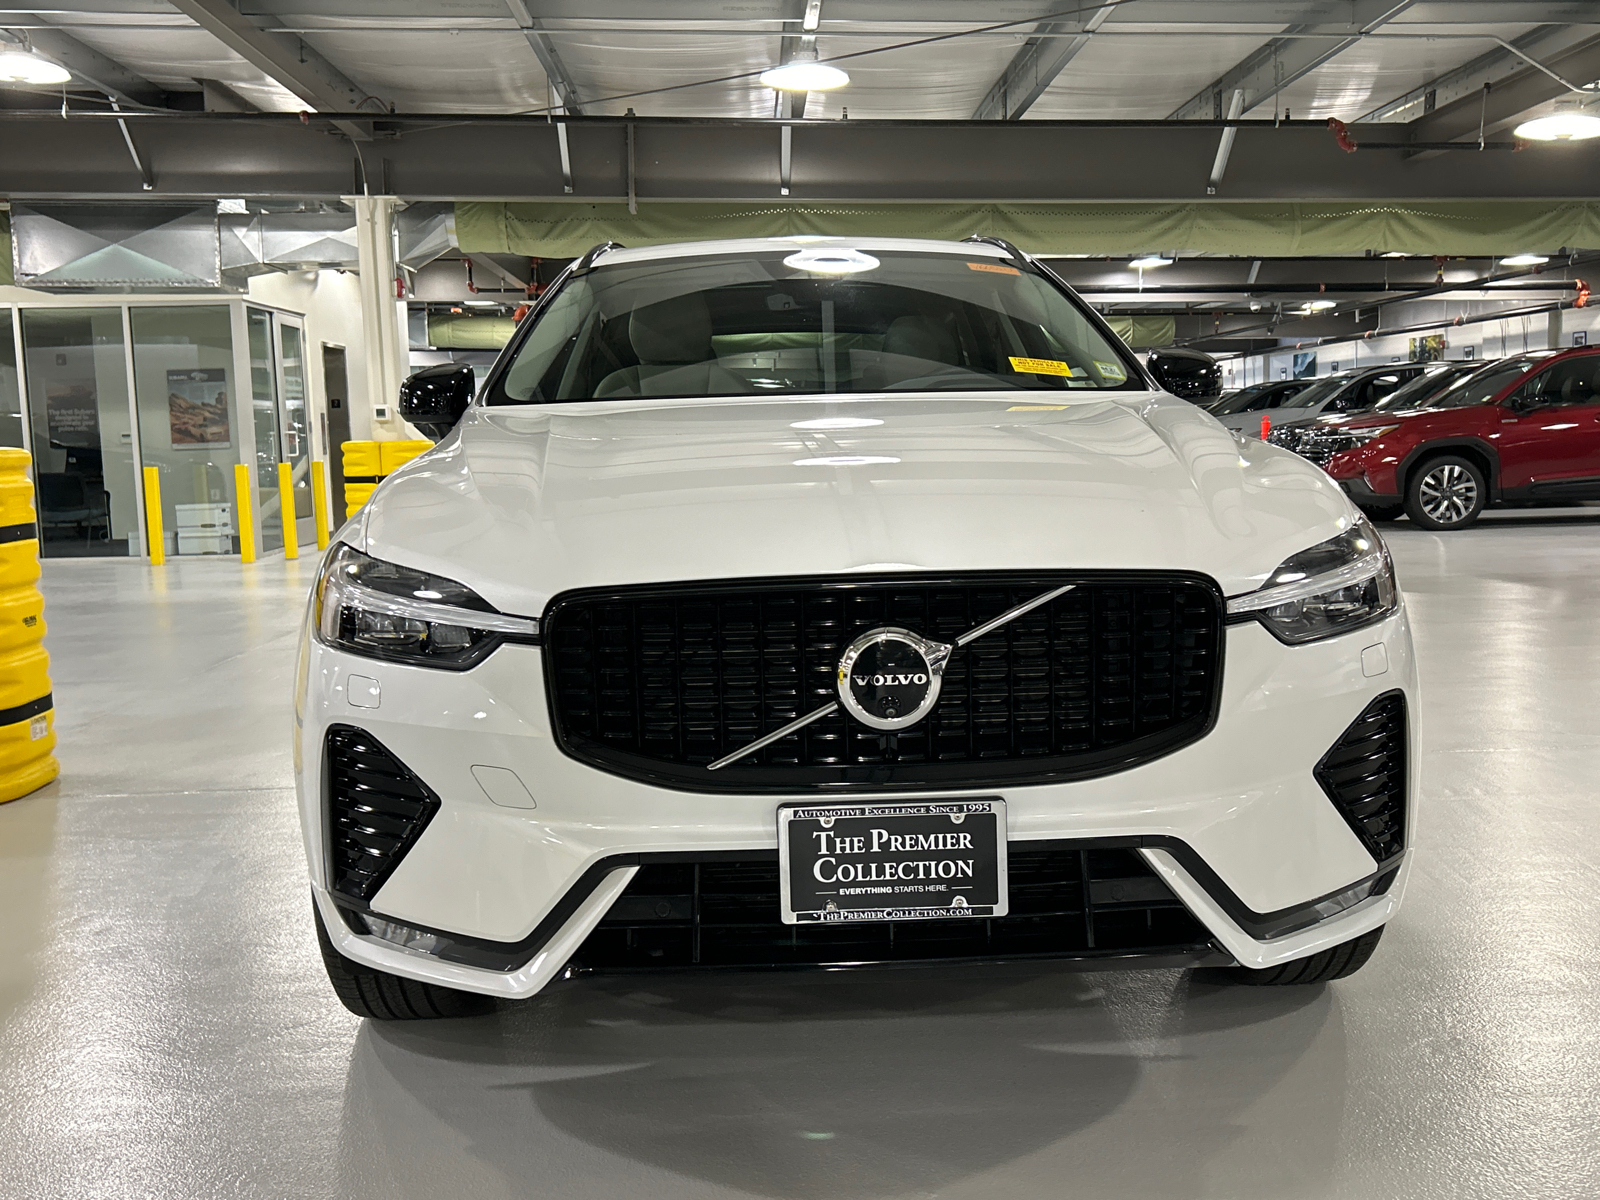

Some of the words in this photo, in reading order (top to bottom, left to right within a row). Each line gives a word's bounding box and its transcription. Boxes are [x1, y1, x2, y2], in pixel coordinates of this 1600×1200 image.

[853, 673, 928, 686] VOLVO
[796, 808, 862, 818] AUTOMOTIVE
[865, 806, 927, 816] EXCELLENCE
[929, 805, 959, 814] SINCE
[962, 803, 990, 812] 1995
[813, 830, 866, 855] THE
[870, 828, 974, 852] PREMIER
[813, 857, 974, 883] COLLECTION
[839, 886, 892, 895] EVERYTHING
[894, 885, 924, 894] STARTS
[925, 884, 949, 893] HERE.
